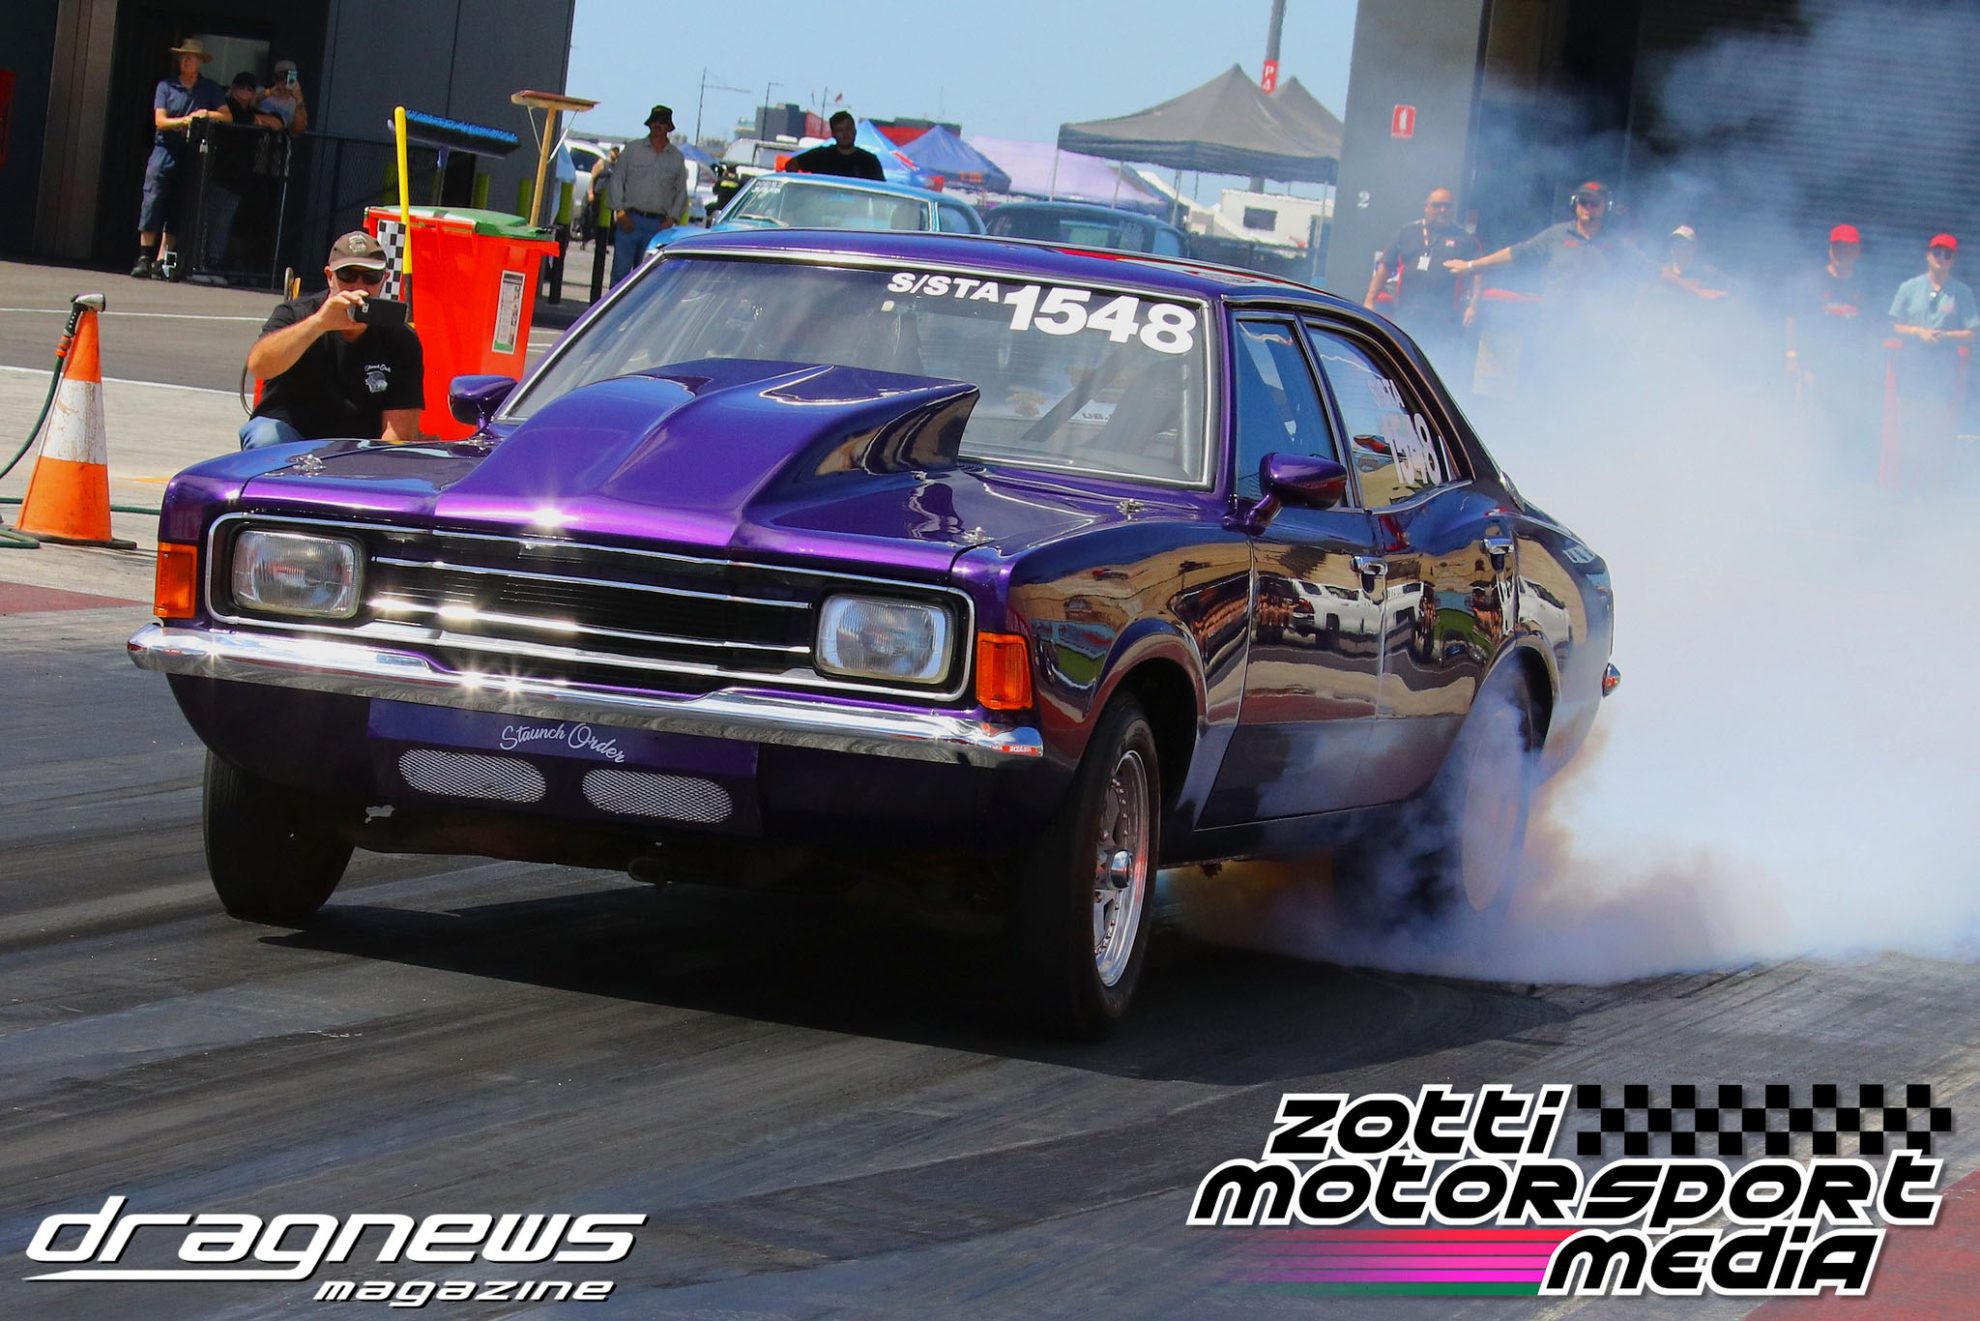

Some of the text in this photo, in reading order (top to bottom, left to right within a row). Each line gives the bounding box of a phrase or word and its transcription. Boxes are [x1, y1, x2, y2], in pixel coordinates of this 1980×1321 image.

[1357, 190, 1371, 209] 2
[886, 271, 1197, 355] S/STA 1548
[499, 722, 626, 764] Staunch Order
